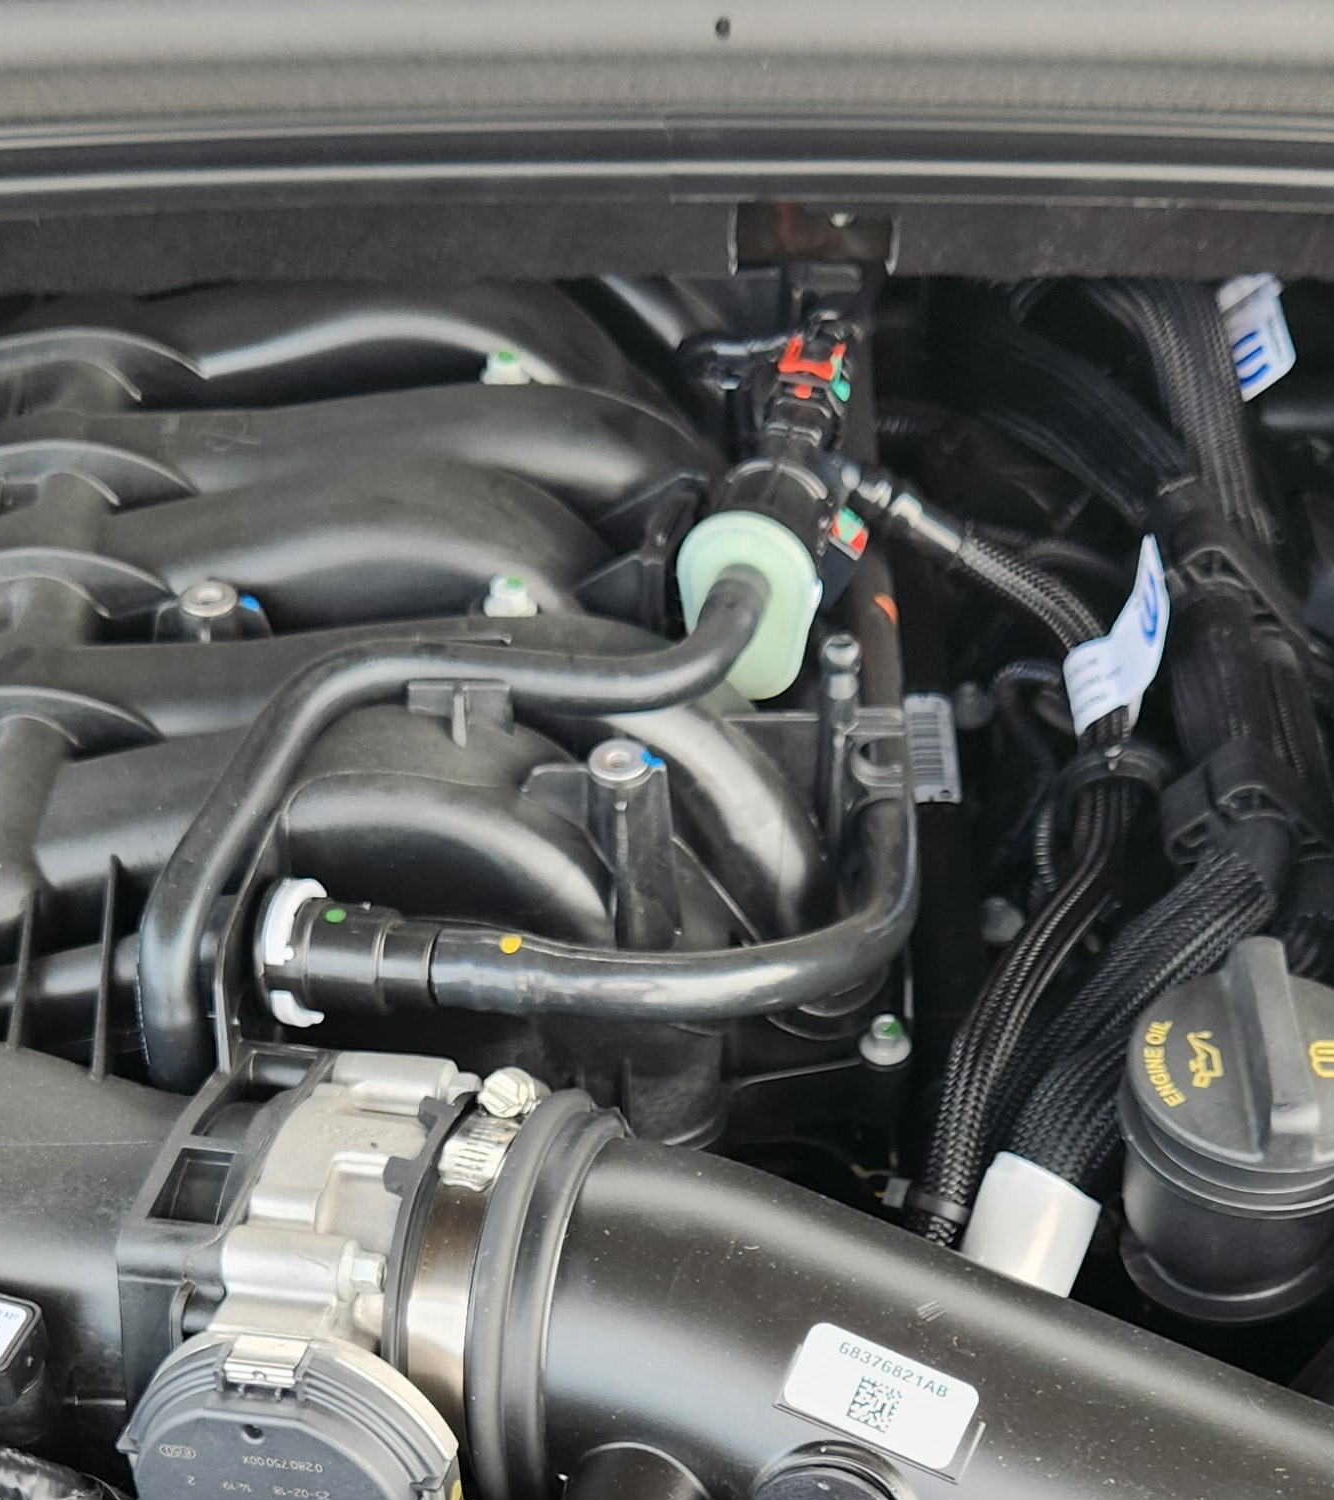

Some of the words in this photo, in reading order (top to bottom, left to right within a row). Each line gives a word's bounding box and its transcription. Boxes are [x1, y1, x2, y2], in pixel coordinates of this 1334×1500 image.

[1145, 1020, 1173, 1046] OIL
[1143, 1046, 1186, 1107] ENGINE
[839, 1342, 949, 1398] 68376821AB
[273, 1486, 330, 1500] 25-02-18
